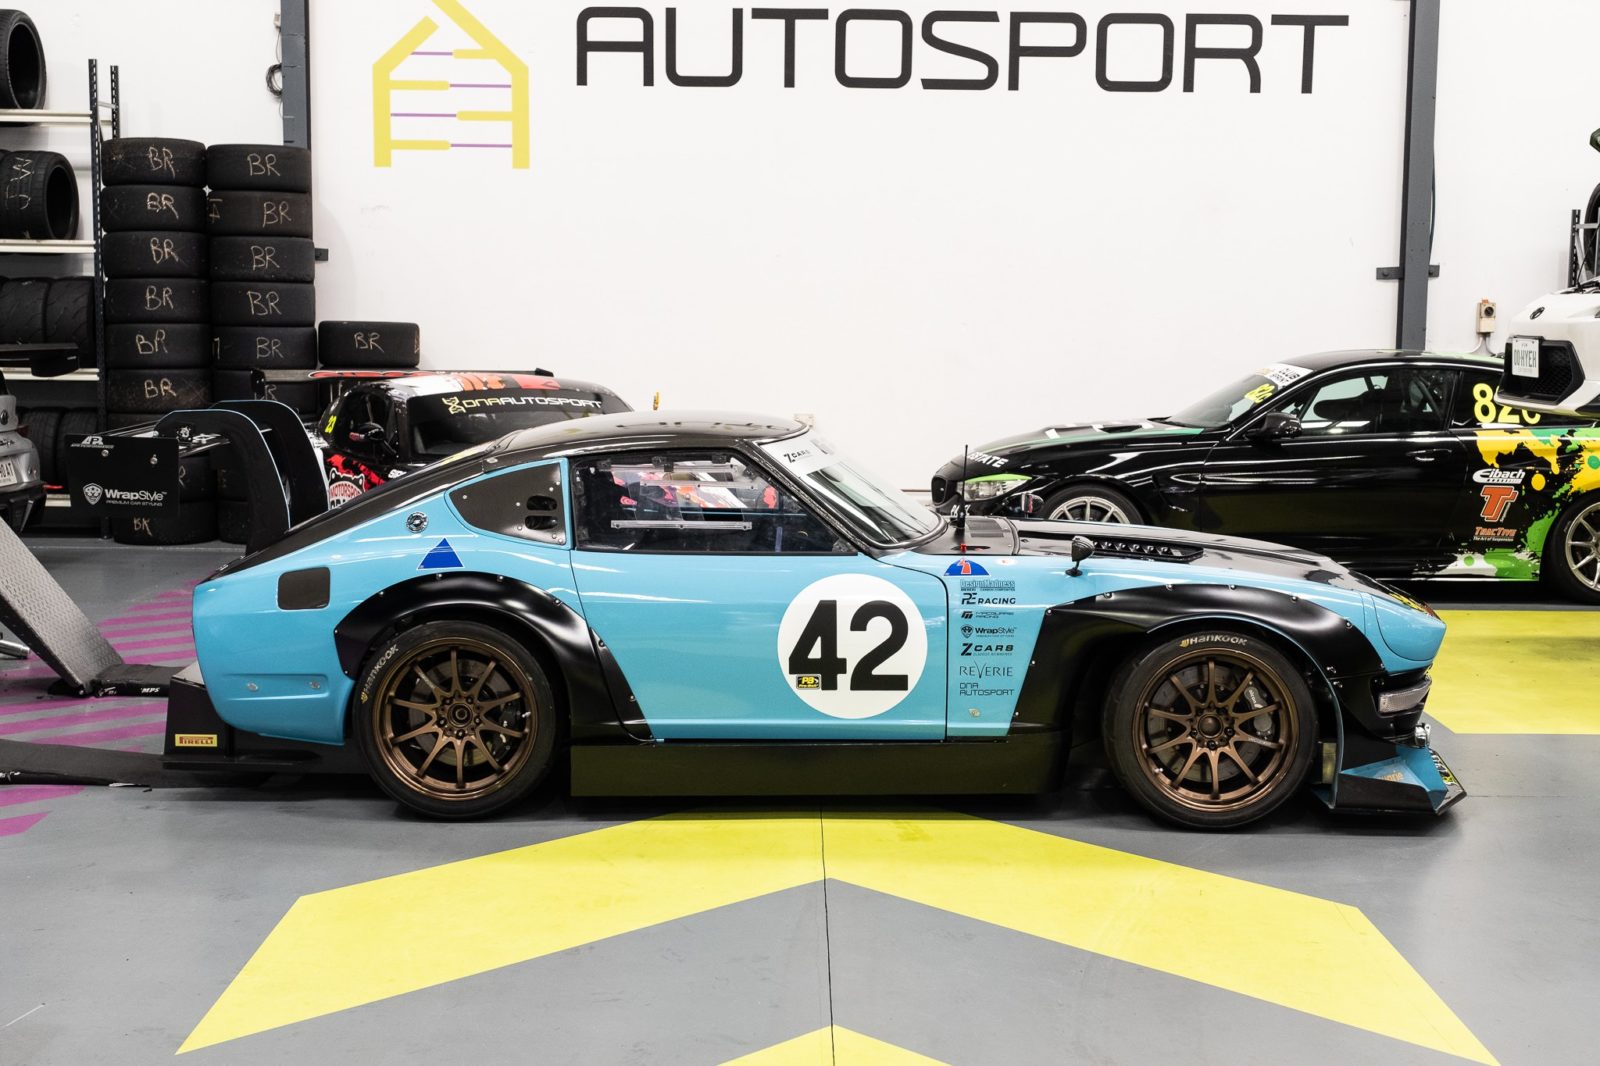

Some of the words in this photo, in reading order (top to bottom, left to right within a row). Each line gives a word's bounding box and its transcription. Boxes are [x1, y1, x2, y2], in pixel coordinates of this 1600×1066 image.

[577, 7, 1349, 94] AUTOSPORT
[149, 147, 176, 179] BR
[247, 153, 281, 177] BR
[147, 192, 179, 220] BR
[262, 201, 292, 228] BR
[150, 238, 179, 264] BR
[250, 246, 280, 271] BR
[145, 285, 174, 311] BR
[247, 291, 282, 316] BR
[135, 329, 168, 355] BR
[256, 337, 284, 360] BR
[354, 332, 385, 353] BR
[144, 378, 177, 399] BR
[1472, 468, 1526, 484] Eibach
[104, 489, 164, 501] WrapStyle
[789, 600, 908, 691] 42
[959, 689, 1015, 697] AUTOSPORT
[179, 736, 214, 745] PIRELLI
